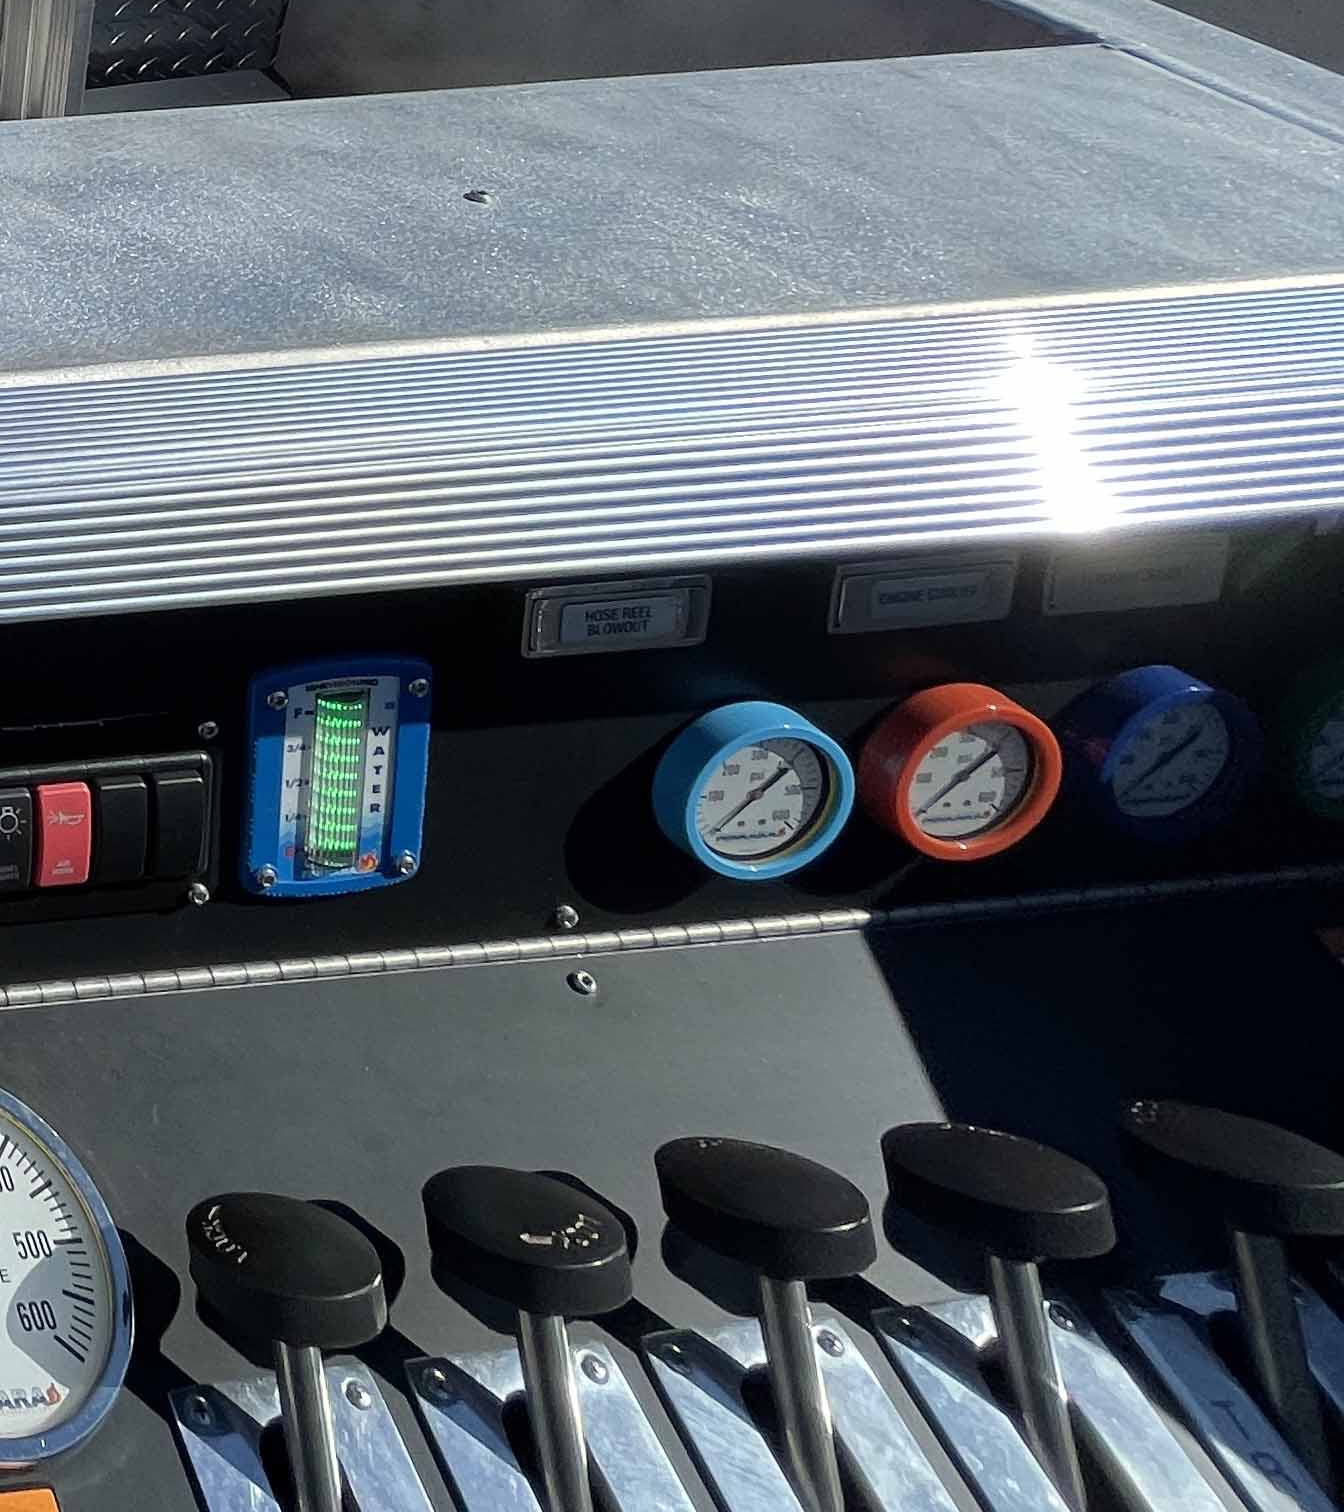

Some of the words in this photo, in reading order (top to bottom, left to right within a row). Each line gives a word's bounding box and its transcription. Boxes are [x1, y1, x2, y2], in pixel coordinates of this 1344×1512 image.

[585, 607, 618, 623] HOSE
[623, 605, 653, 620] REEL
[587, 620, 650, 637] BLOWOUT
[12, 1230, 53, 1260] 500
[15, 1300, 57, 1332] 600
